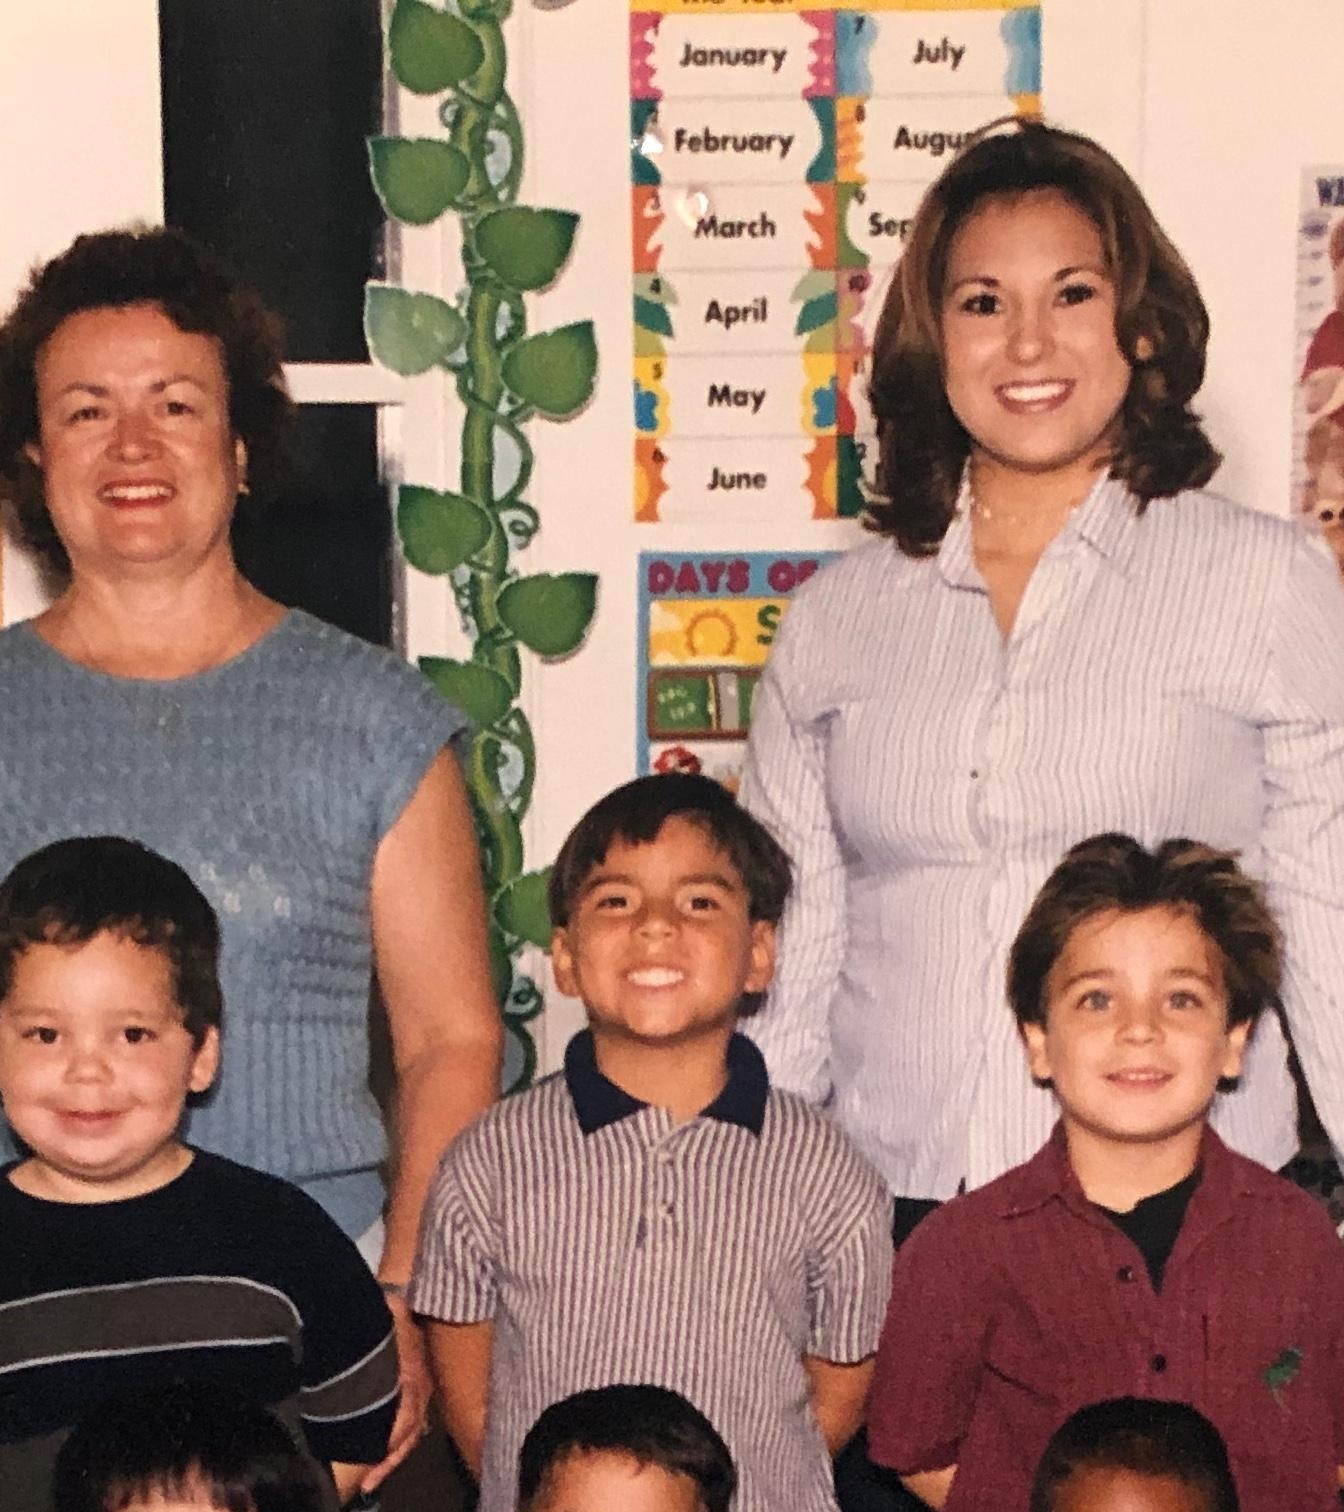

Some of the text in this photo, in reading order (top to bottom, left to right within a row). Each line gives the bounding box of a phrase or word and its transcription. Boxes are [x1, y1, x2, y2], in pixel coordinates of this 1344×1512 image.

[679, 43, 787, 73] January
[912, 37, 965, 71] July
[674, 127, 795, 160] February
[694, 212, 777, 239] March
[705, 296, 768, 331] April
[707, 383, 767, 415] May
[708, 466, 768, 491] June
[648, 560, 751, 594] DAYS
